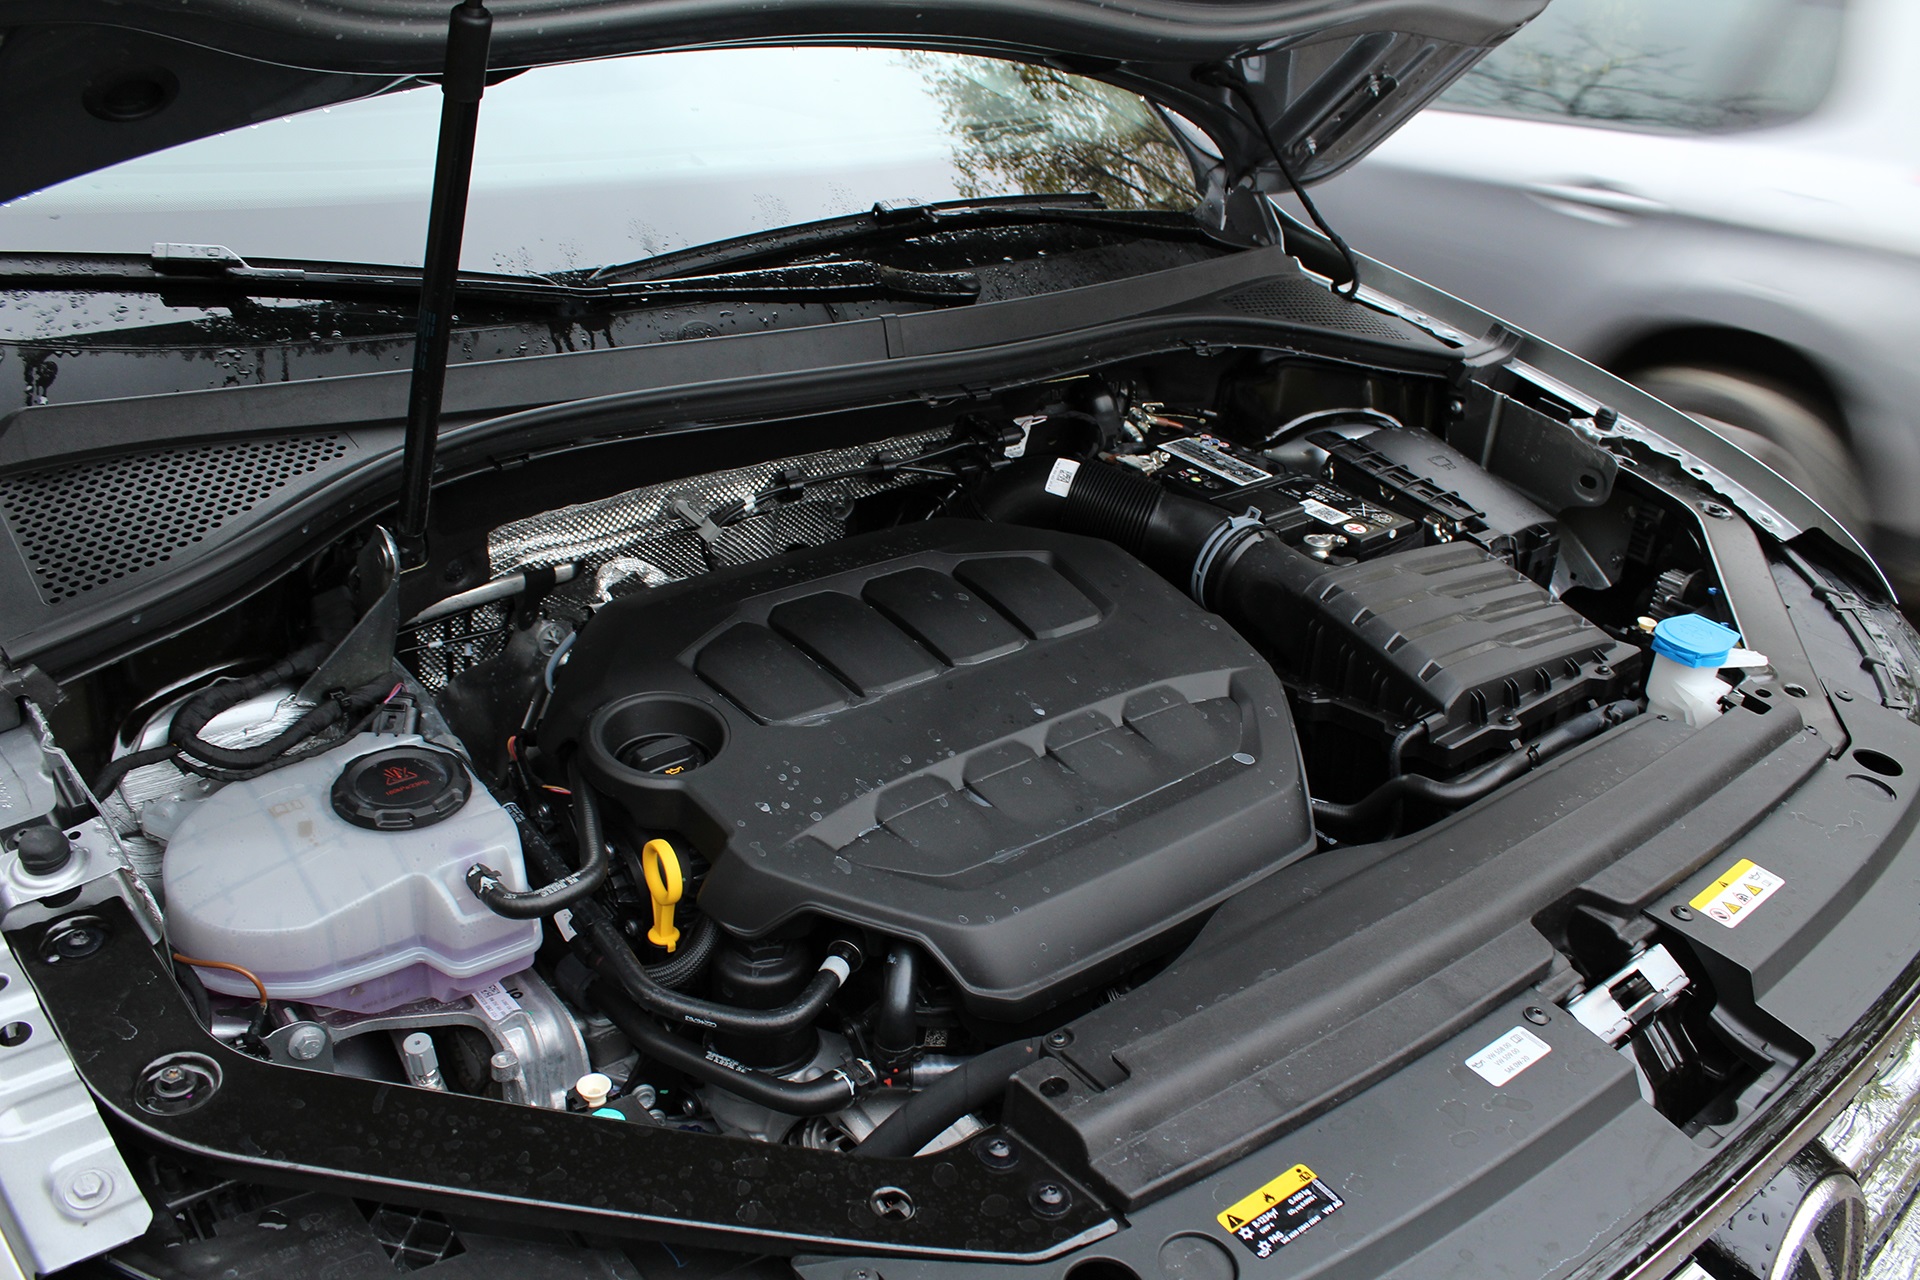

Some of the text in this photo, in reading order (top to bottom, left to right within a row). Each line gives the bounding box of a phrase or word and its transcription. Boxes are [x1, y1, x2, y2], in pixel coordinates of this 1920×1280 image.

[1321, 1199, 1343, 1215] VW AG
[1251, 1208, 1278, 1228] R-1234yf
[1267, 1230, 1284, 1243] PAG
